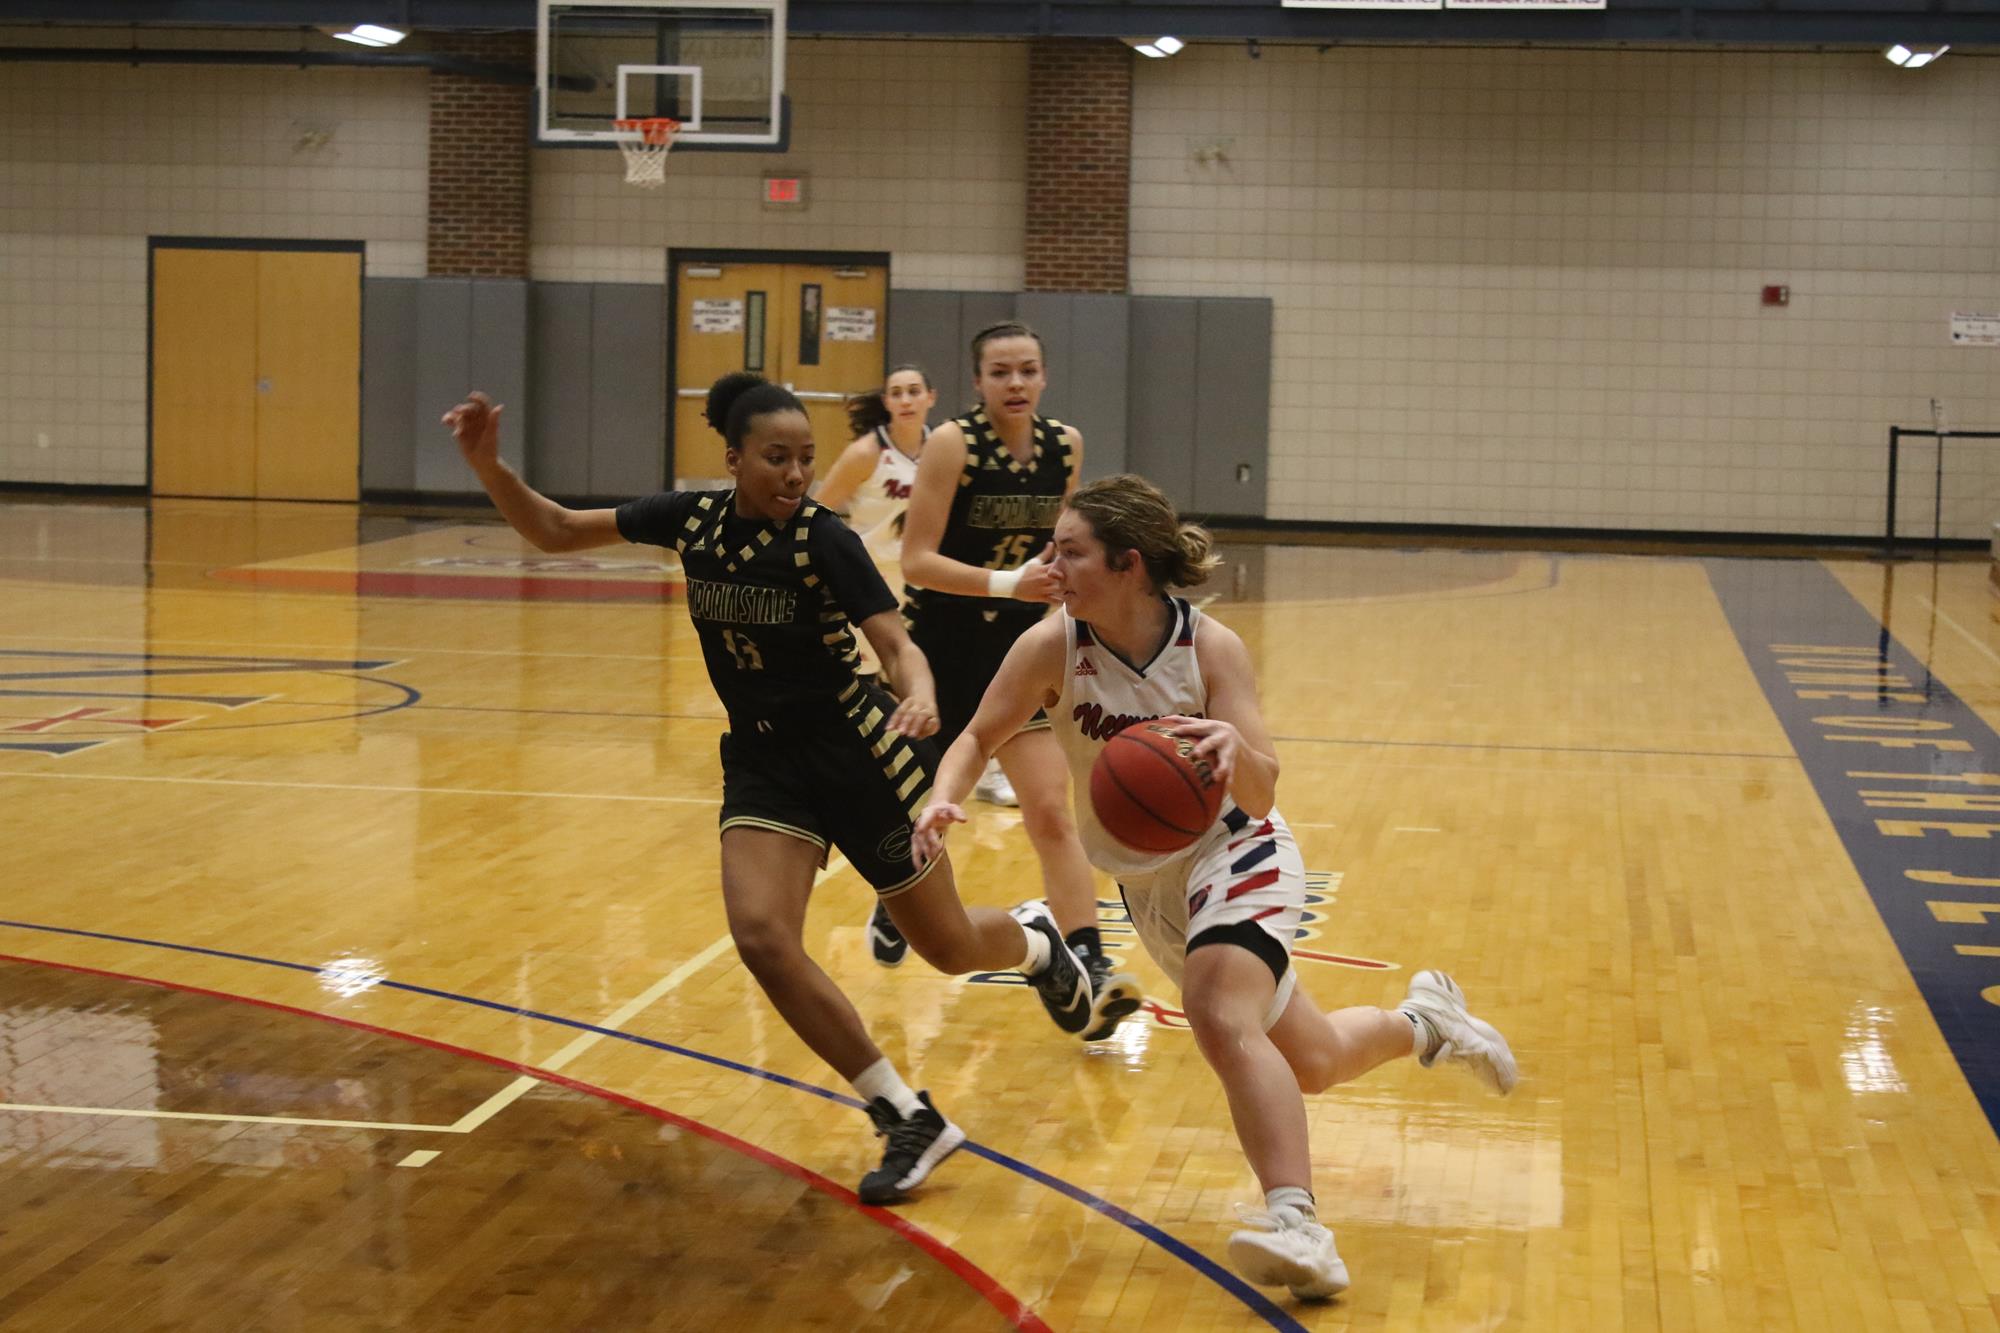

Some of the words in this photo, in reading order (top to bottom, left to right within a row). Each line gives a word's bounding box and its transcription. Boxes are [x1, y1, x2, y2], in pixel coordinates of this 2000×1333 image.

[738, 584, 797, 625] STATE
[1768, 643, 1932, 703] HOME
[1811, 715, 1976, 752] OF
